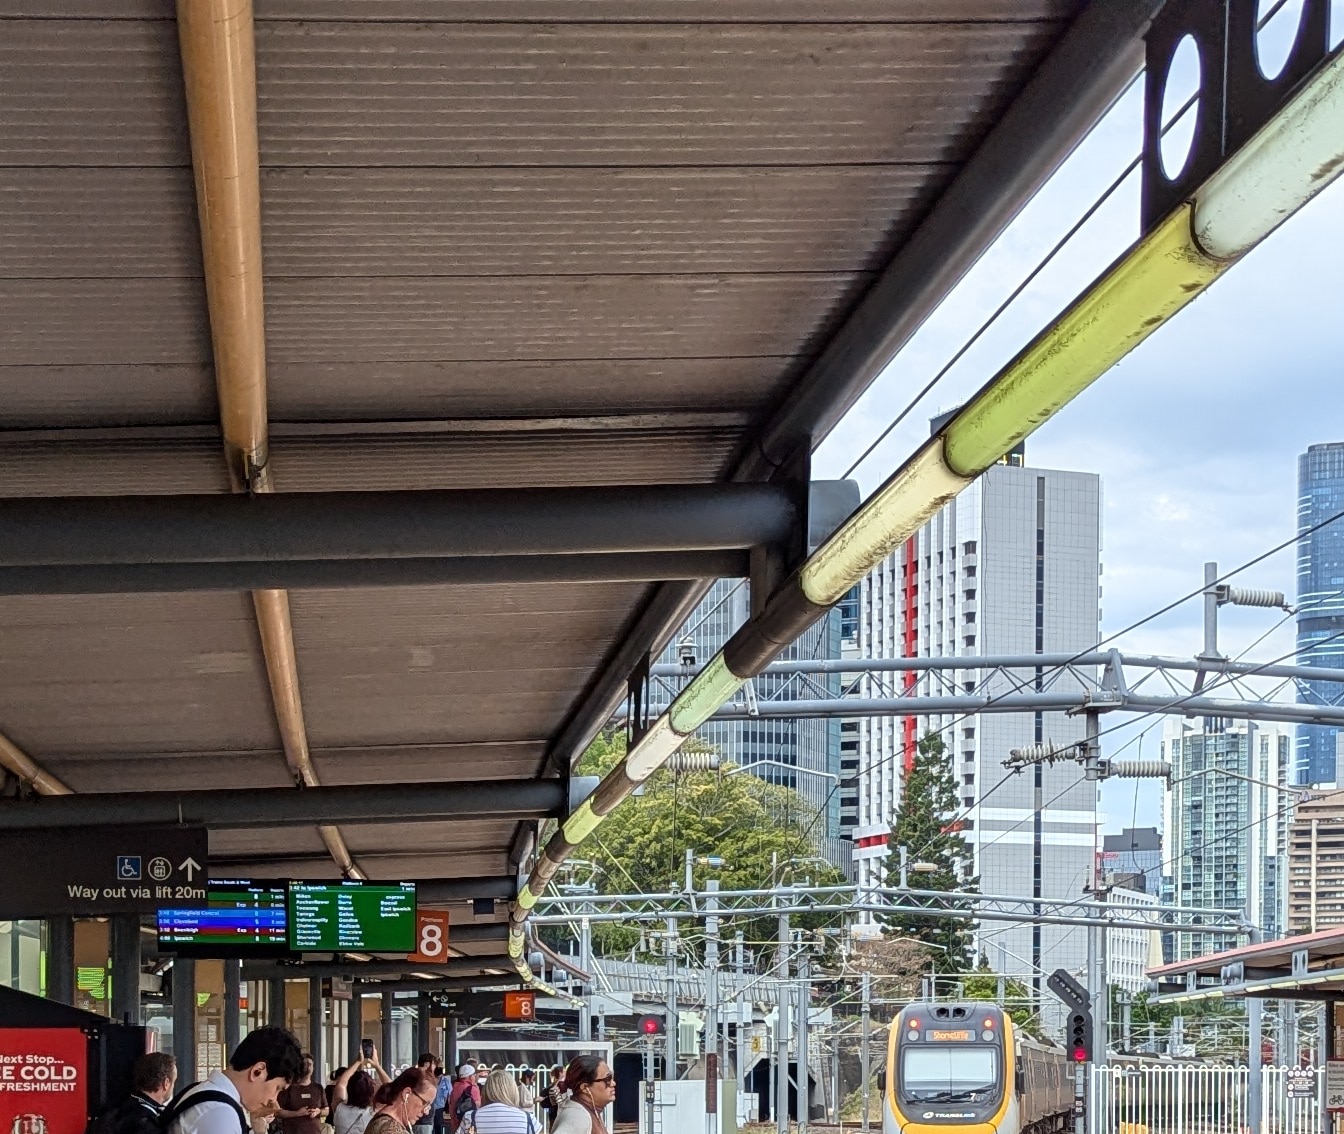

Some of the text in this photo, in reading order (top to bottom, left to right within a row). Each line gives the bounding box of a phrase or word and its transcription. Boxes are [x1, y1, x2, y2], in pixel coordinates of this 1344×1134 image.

[67, 885, 206, 900] Way out via lift 20m
[420, 924, 442, 957] 8
[521, 1001, 531, 1016] 8
[25, 1054, 65, 1065] Stop...
[20, 1065, 77, 1080] COLD
